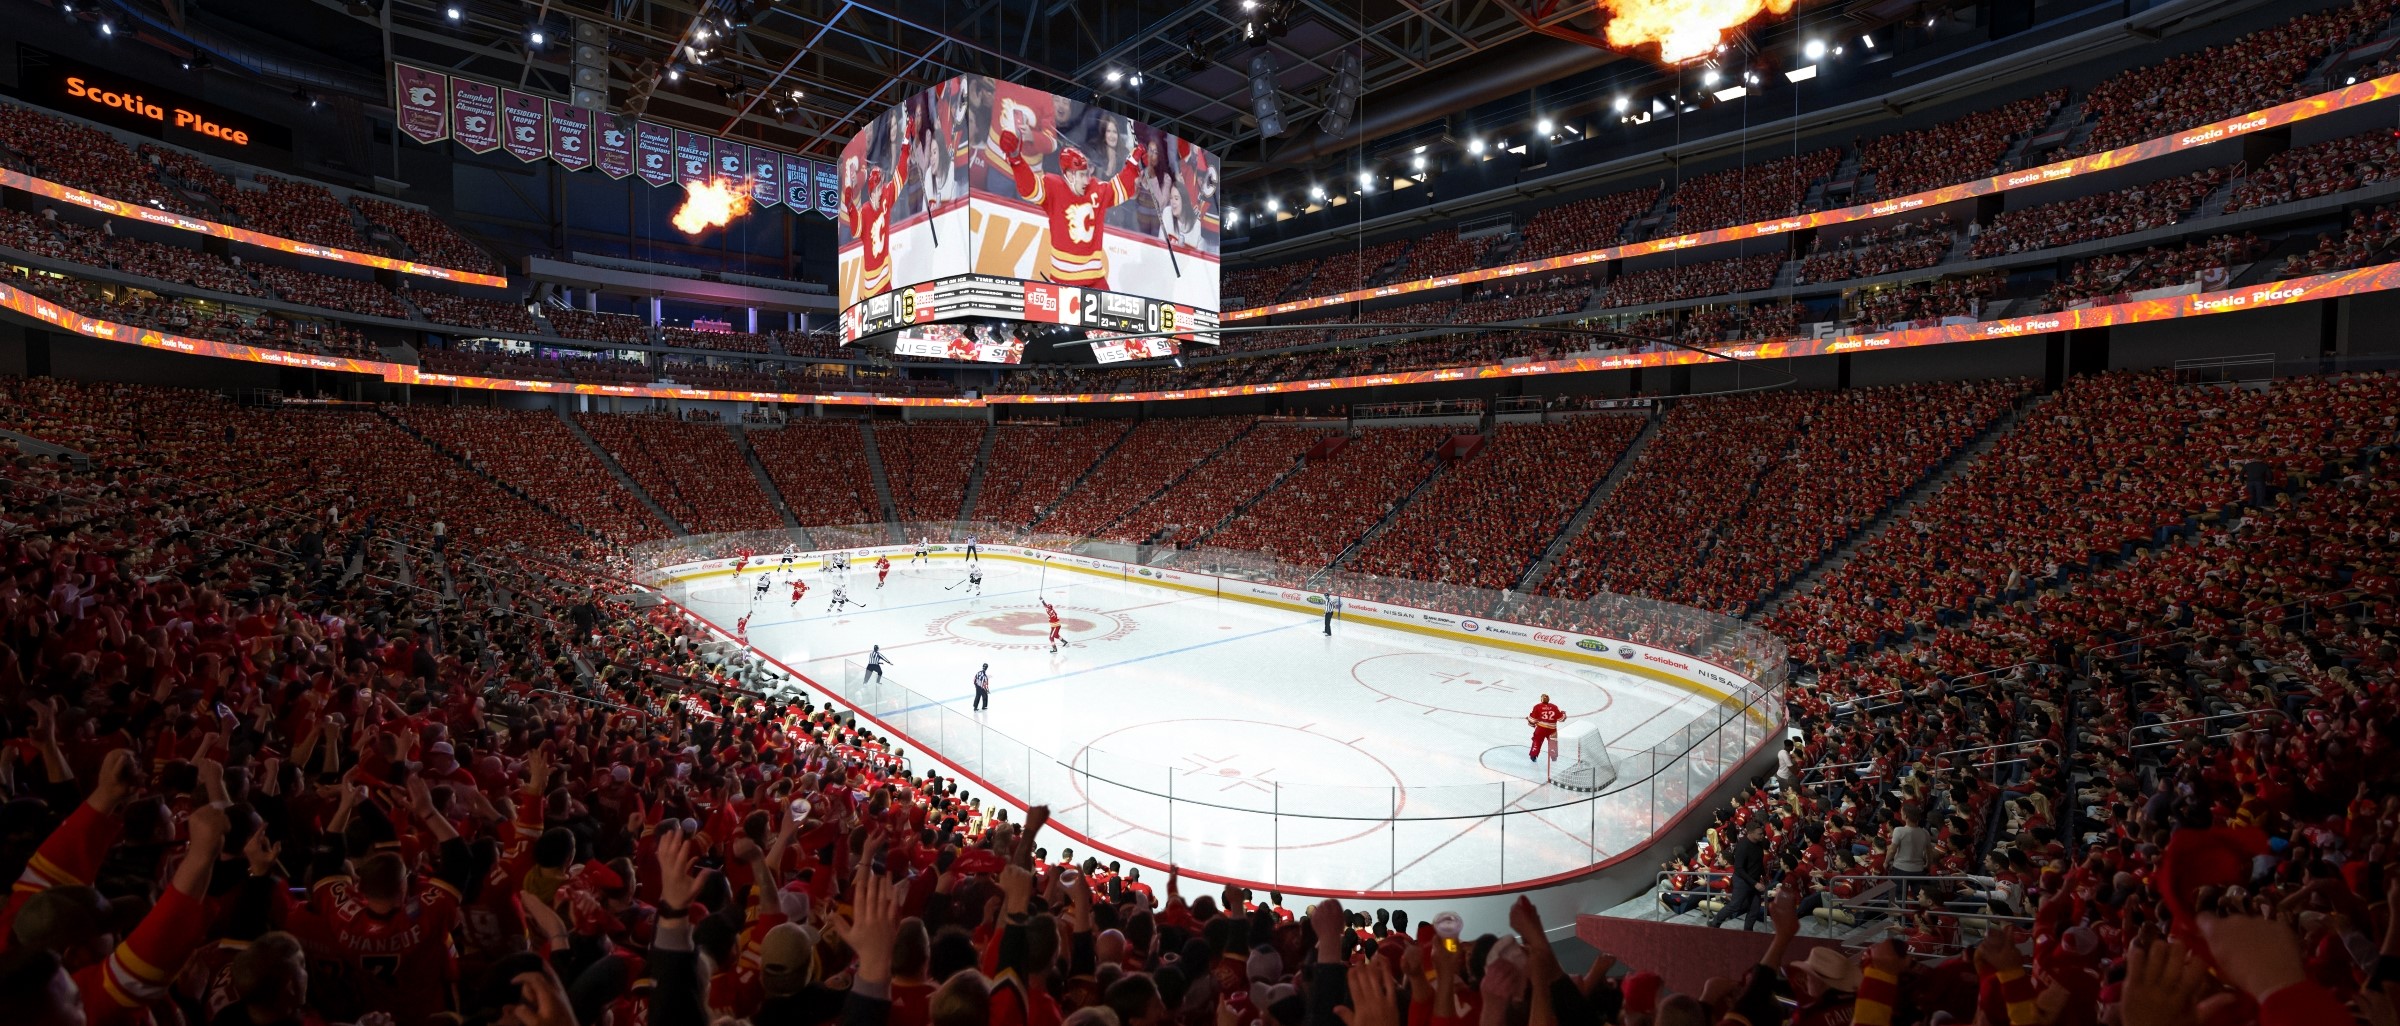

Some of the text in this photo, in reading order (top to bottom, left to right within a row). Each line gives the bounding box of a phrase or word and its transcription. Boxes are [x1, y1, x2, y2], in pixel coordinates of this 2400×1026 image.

[457, 90, 494, 104] Campbell
[66, 77, 249, 146] Scotia Place
[455, 102, 496, 117] Champions
[512, 115, 537, 126] TROPHY
[559, 125, 582, 136] TROPHY
[640, 131, 670, 143] Campbell
[2181, 116, 2268, 146] Scotia Place
[639, 142, 671, 155] Champions
[677, 145, 710, 157] STANLEY CUP
[678, 152, 708, 163] CHAMPIONS
[787, 169, 808, 187] WESTERN
[2008, 166, 2072, 186] Scotia Place
[65, 191, 116, 212] Scotia Place
[1872, 199, 1924, 215] Scotia Place
[140, 211, 208, 232] Scotia Place
[1757, 221, 1801, 234] Scotia Place
[1658, 238, 1697, 250] Scotia Place
[294, 245, 344, 260] Scotia Place
[1572, 253, 1606, 264] Scotia Place
[410, 266, 450, 278] Scotia Place
[974, 276, 993, 284] TIME
[1035, 294, 1044, 304] 50
[1046, 299, 1055, 309] 50
[1107, 294, 1140, 316] 12:55
[2193, 286, 2305, 311] Scotia Place
[893, 293, 901, 324] 0
[905, 295, 914, 317] B
[1084, 293, 1098, 324] 2
[862, 304, 869, 332] 2
[1101, 317, 1109, 328] 23
[1147, 302, 1158, 332] 0
[1163, 309, 1175, 329] B
[1137, 322, 1145, 332] 11
[1987, 318, 2060, 335] Scotia Place
[161, 338, 195, 351] Scotia Place
[895, 342, 947, 356] NISS
[1834, 337, 1891, 350] Scotia Place
[261, 352, 282, 363] Scotia
[283, 355, 301, 365] Place
[310, 358, 336, 368] Place
[1096, 348, 1126, 362] NISS
[1734, 349, 1756, 358] Place
[1601, 358, 1642, 367] Scotia Place
[1511, 365, 1546, 374] Scotia Place
[437, 374, 457, 383] Place
[515, 380, 534, 388] Scotia
[1348, 602, 1378, 613] Scotiabank
[1383, 609, 1415, 619] NISSAN
[1464, 622, 1477, 630] Esso
[1533, 631, 1568, 646] Coca-Cola
[1578, 640, 1597, 650] PIZZA
[1644, 653, 1689, 672] Scotiabank
[1541, 710, 1556, 720] 32
[338, 923, 423, 952] PHANEUF
